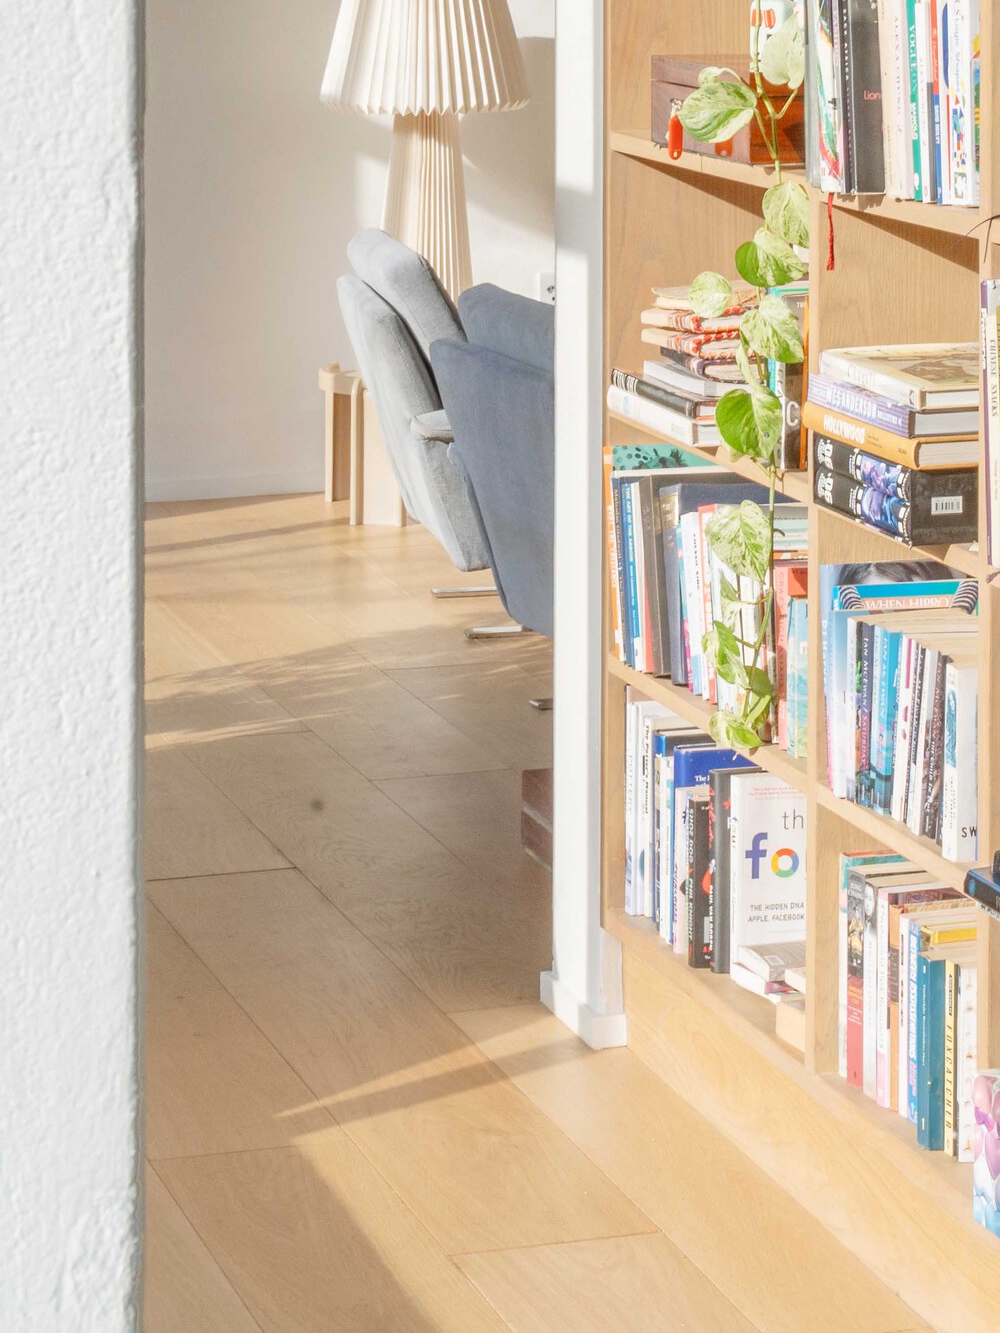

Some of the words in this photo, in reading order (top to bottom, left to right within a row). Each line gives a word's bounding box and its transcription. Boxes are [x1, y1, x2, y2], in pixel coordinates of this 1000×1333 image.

[908, 24, 918, 70] VOGUE
[841, 390, 878, 420] ANDERSON
[823, 413, 866, 445] HOLLYWOOD
[865, 599, 906, 610] WHEN
[860, 714, 868, 765] SATURDAY
[782, 809, 804, 830] th
[748, 915, 769, 923] APPLE,
[772, 914, 805, 922] FACEBOOK
[765, 903, 788, 911] HIDDEN
